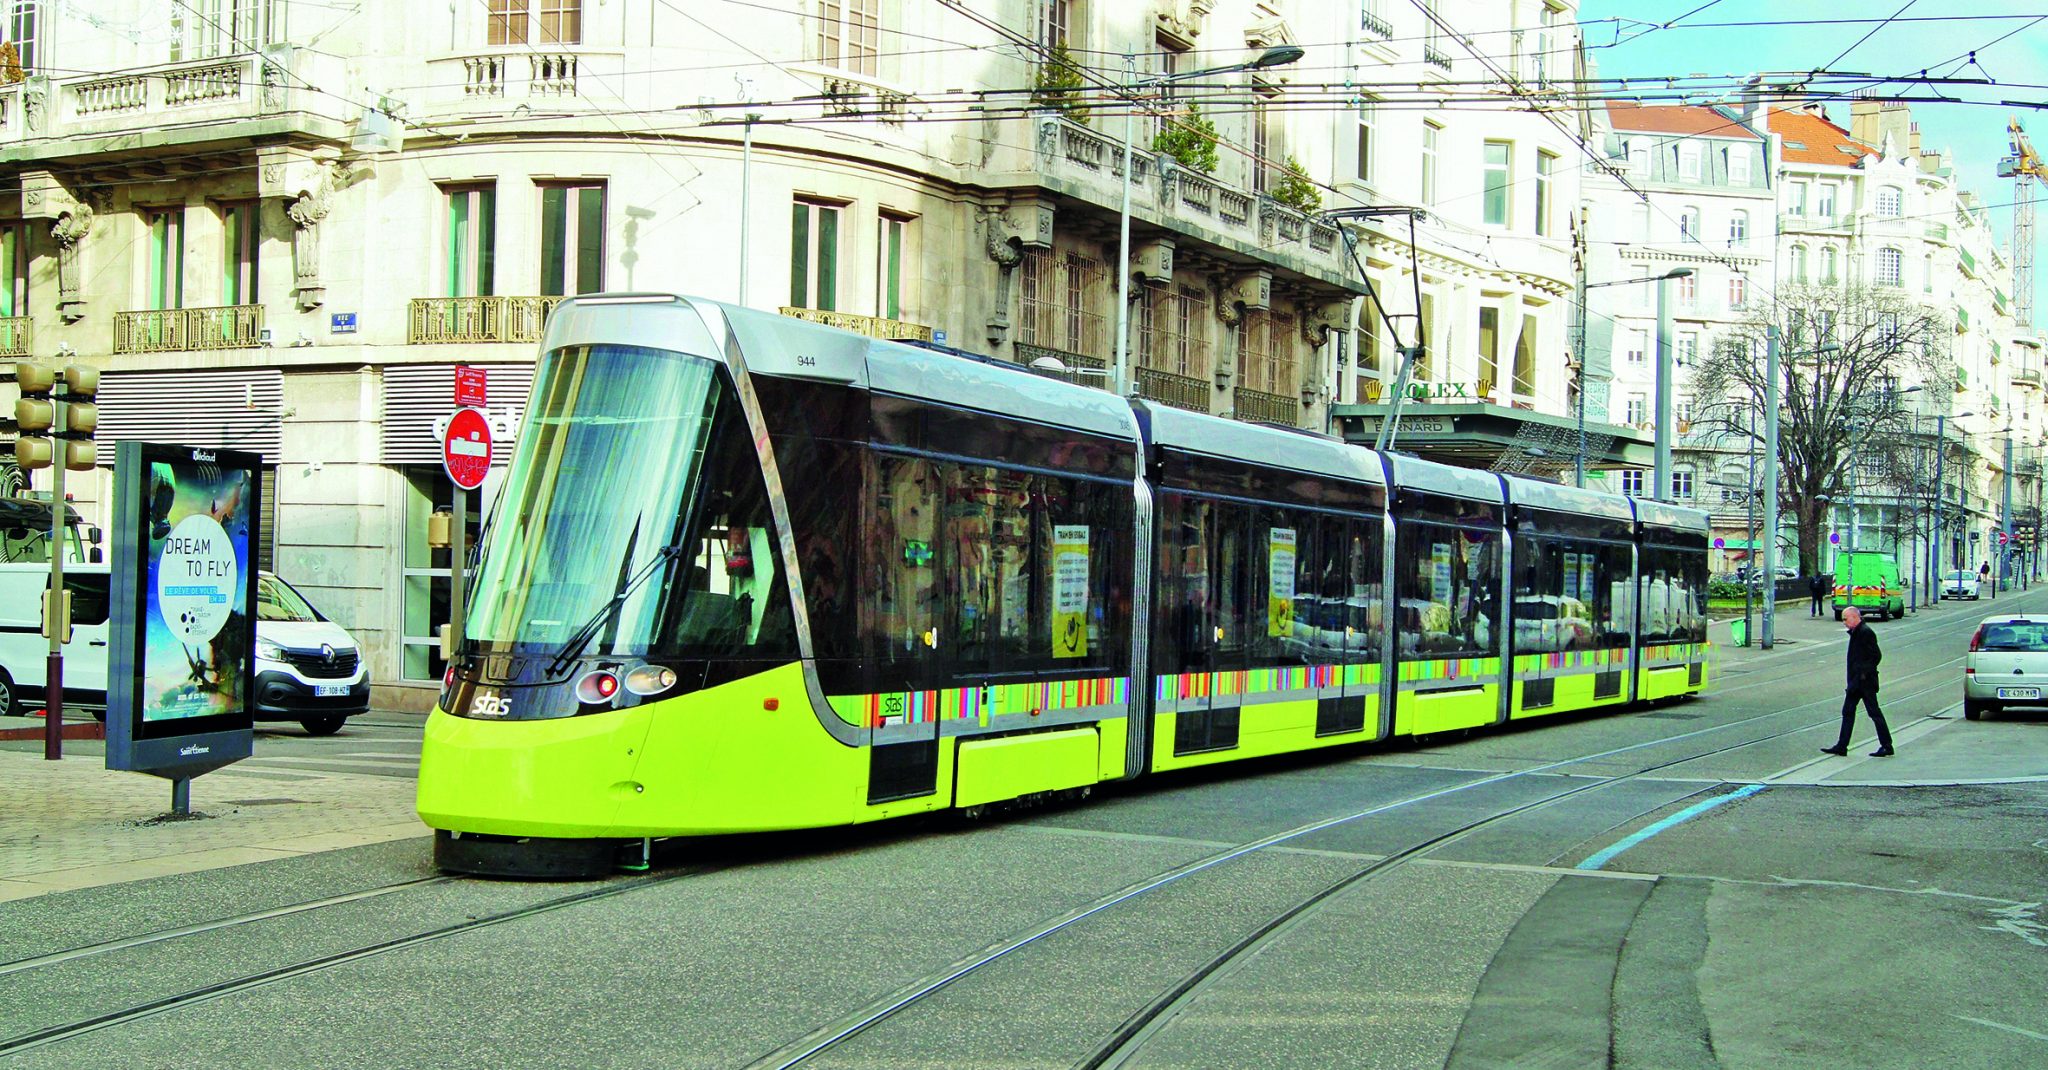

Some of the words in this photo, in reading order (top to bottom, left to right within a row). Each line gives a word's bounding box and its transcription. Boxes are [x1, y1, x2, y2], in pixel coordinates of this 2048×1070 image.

[797, 355, 815, 366] 944
[166, 537, 211, 555] DREAM
[186, 560, 202, 577] TO
[207, 560, 231, 577] FLY
[472, 691, 512, 716] stas
[885, 691, 903, 712] stas
